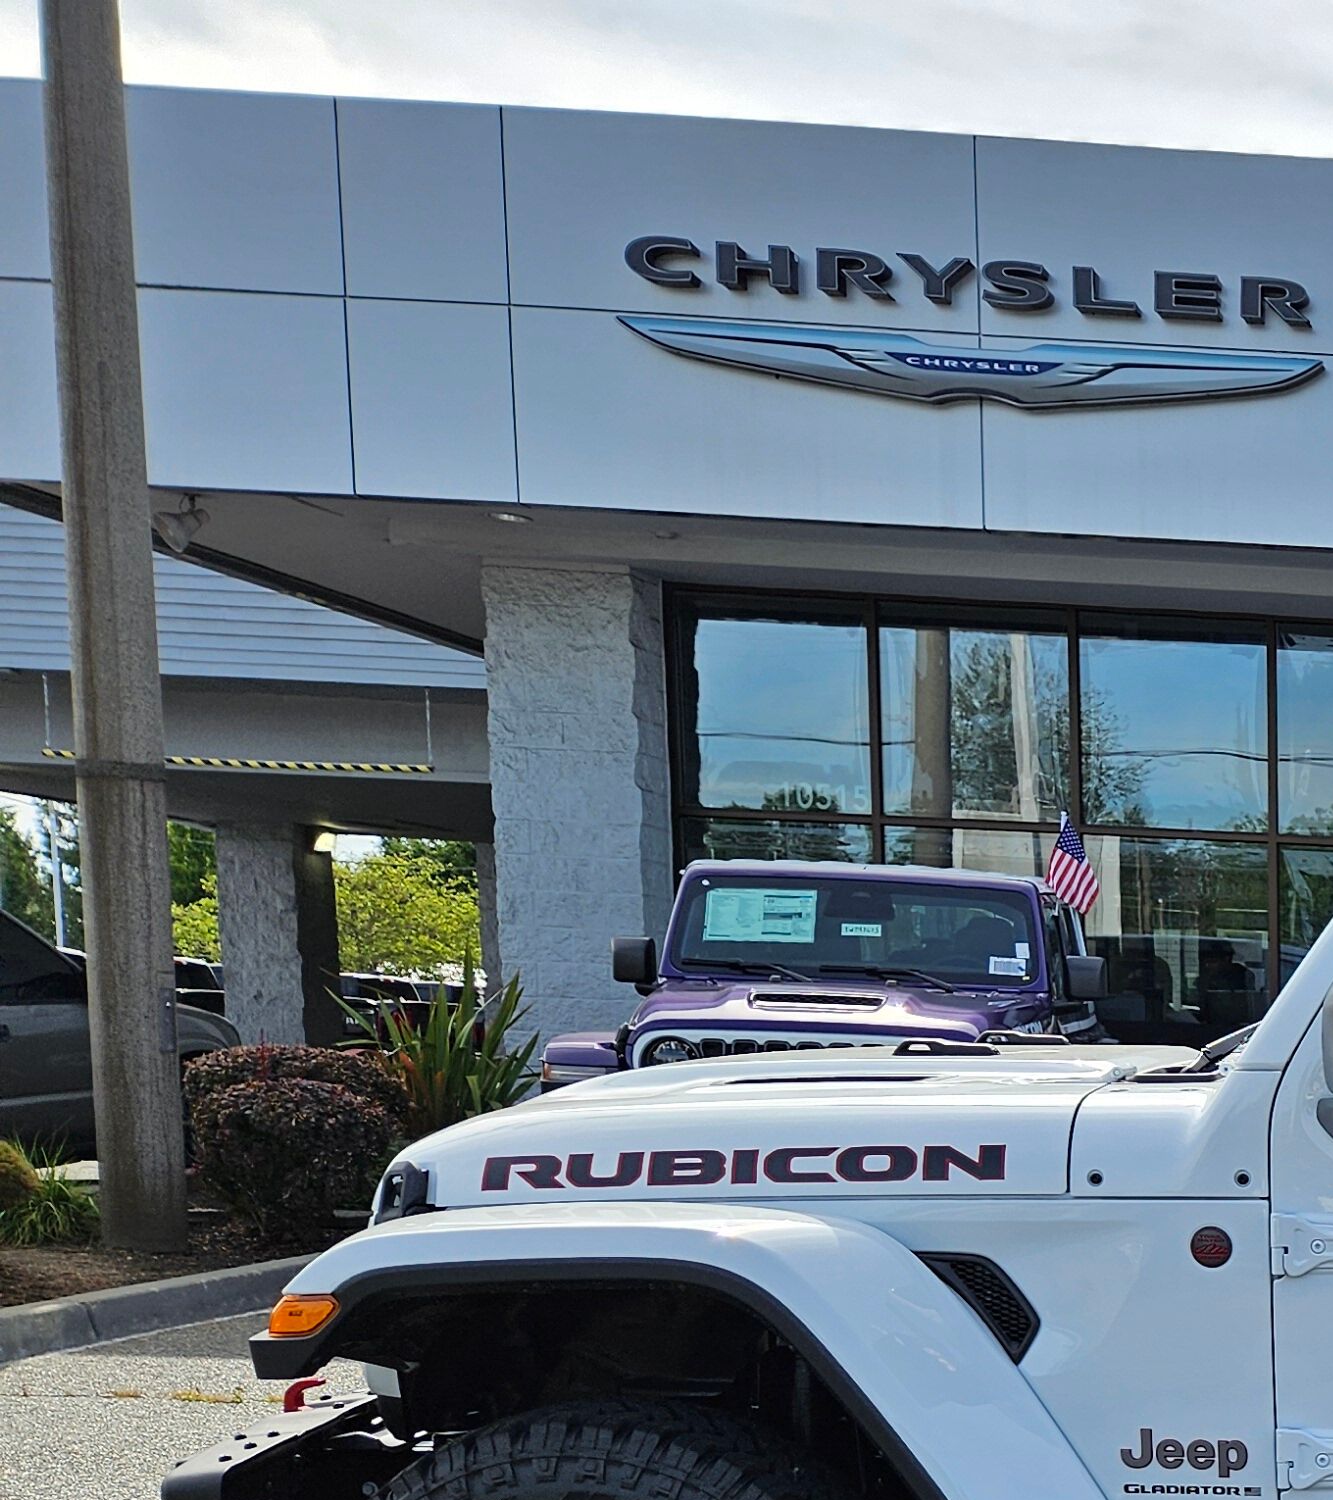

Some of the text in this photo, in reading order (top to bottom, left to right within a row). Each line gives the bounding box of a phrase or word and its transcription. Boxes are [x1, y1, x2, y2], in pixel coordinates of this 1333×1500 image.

[624, 235, 1313, 328] CHRYSLER
[906, 356, 1039, 373] CHRYSLER
[783, 782, 868, 811] 10515
[481, 1144, 1006, 1191] RUBICON
[1120, 1428, 1248, 1478] Jeep
[1123, 1484, 1241, 1496] GLADIATOR
